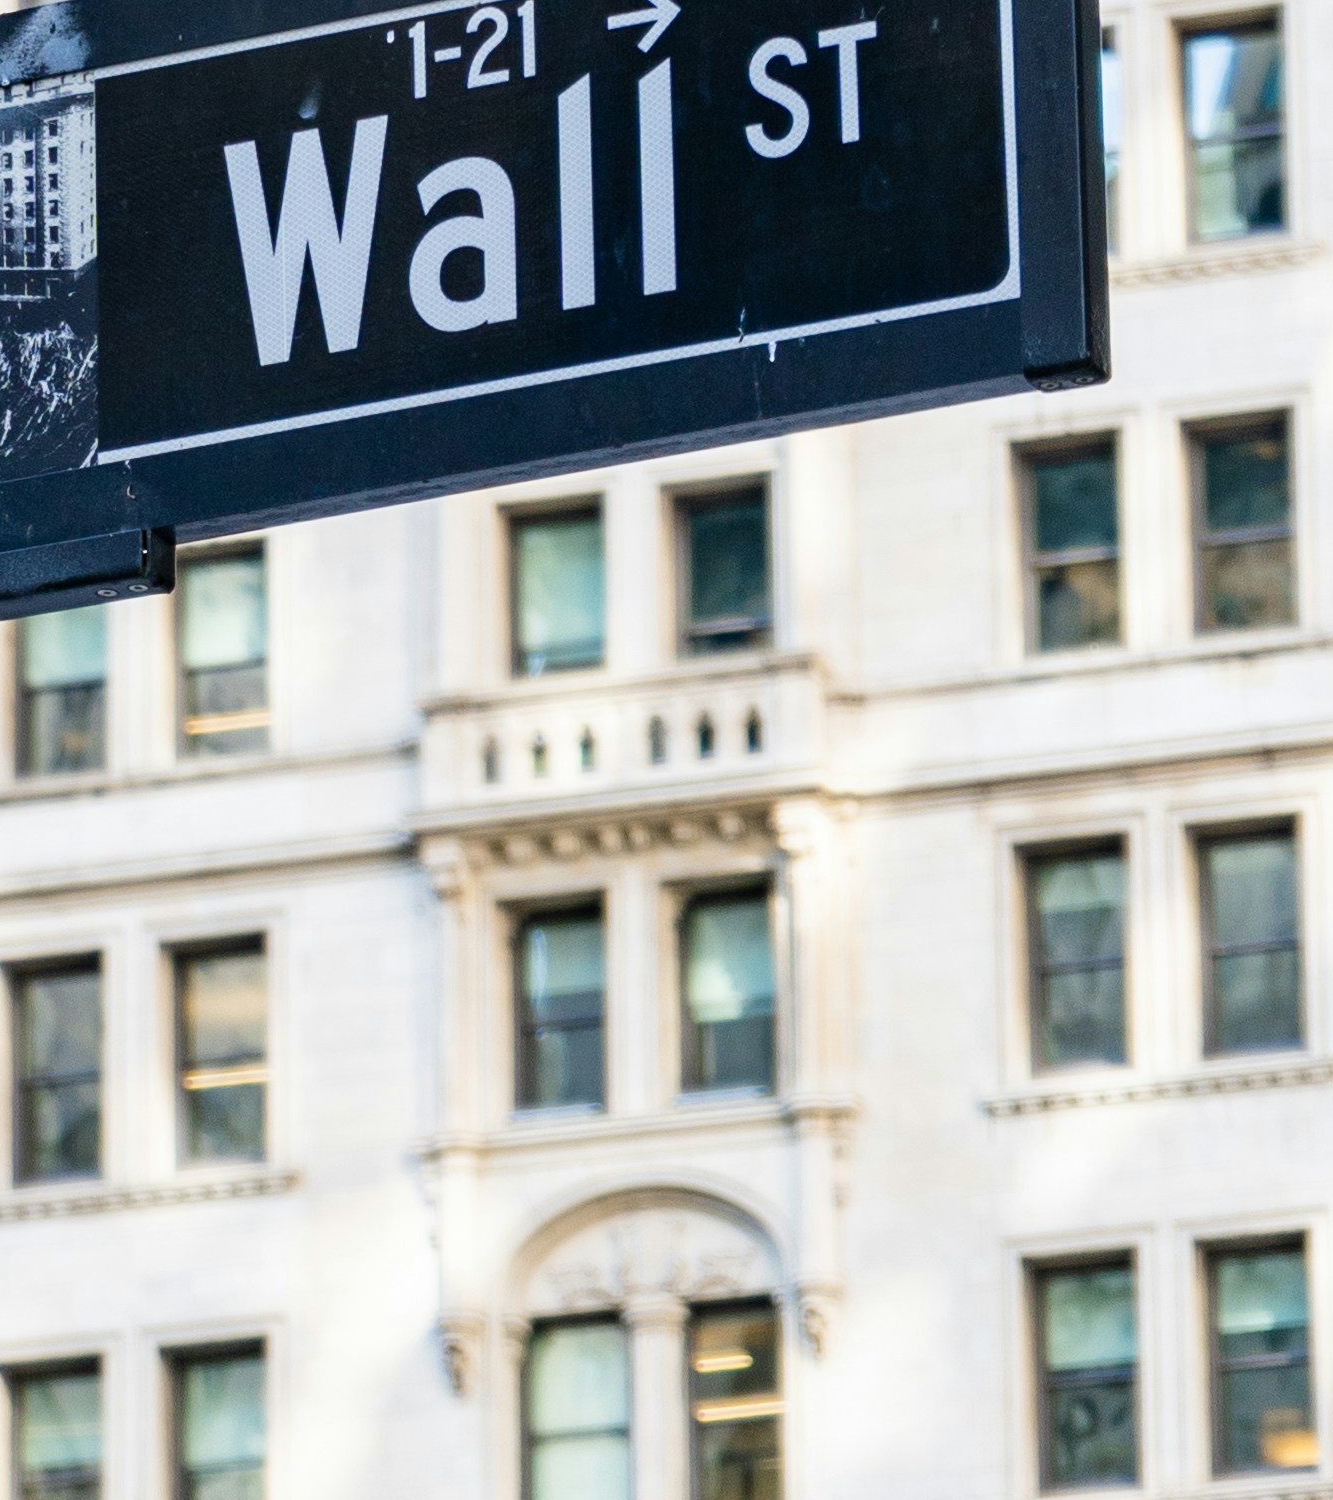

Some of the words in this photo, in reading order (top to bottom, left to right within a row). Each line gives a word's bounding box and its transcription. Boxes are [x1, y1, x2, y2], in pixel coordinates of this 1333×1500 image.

[407, 1, 536, 98] 1-21
[224, 59, 678, 366] Wall
[745, 20, 877, 159] ST
